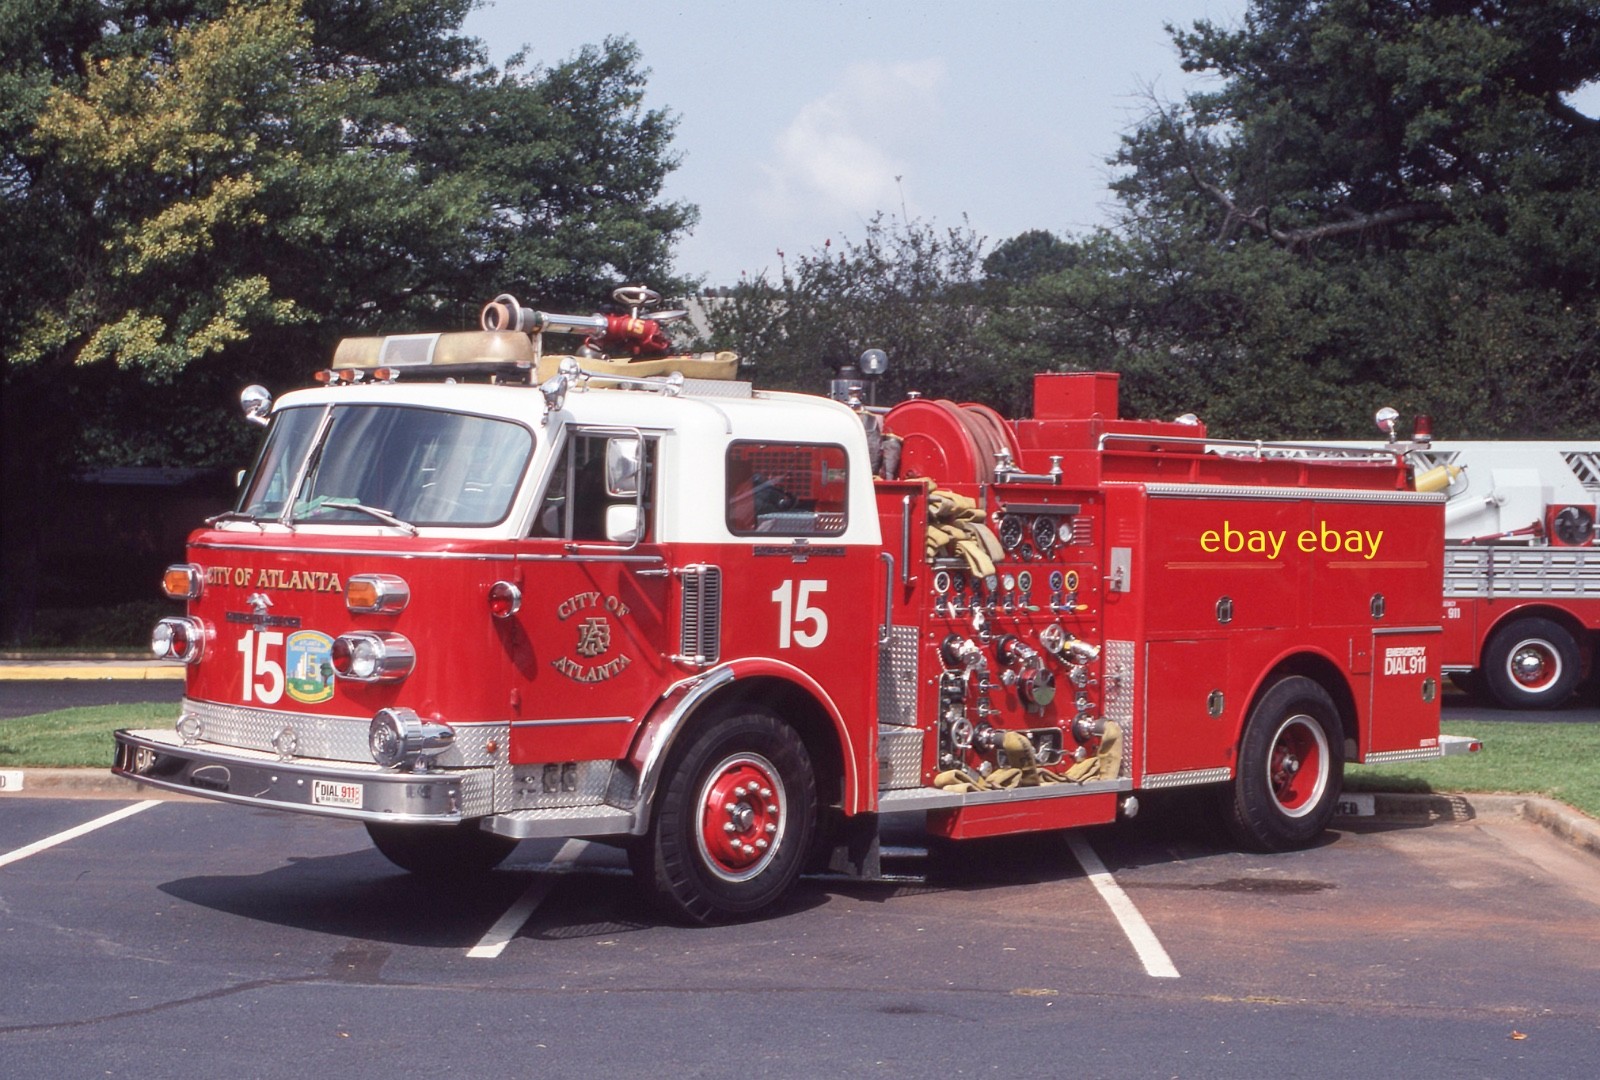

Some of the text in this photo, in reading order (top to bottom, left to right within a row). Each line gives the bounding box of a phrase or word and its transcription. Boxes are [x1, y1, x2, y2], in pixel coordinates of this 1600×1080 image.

[207, 566, 343, 593] CITY OF ATLANTA
[557, 591, 631, 620] CITY OF
[771, 579, 829, 649] 15
[238, 629, 285, 705] 15
[552, 654, 632, 682] ATLANTA
[1384, 655, 1427, 676] DIAL 911
[320, 784, 339, 797] DIAL
[341, 786, 355, 798] 911
